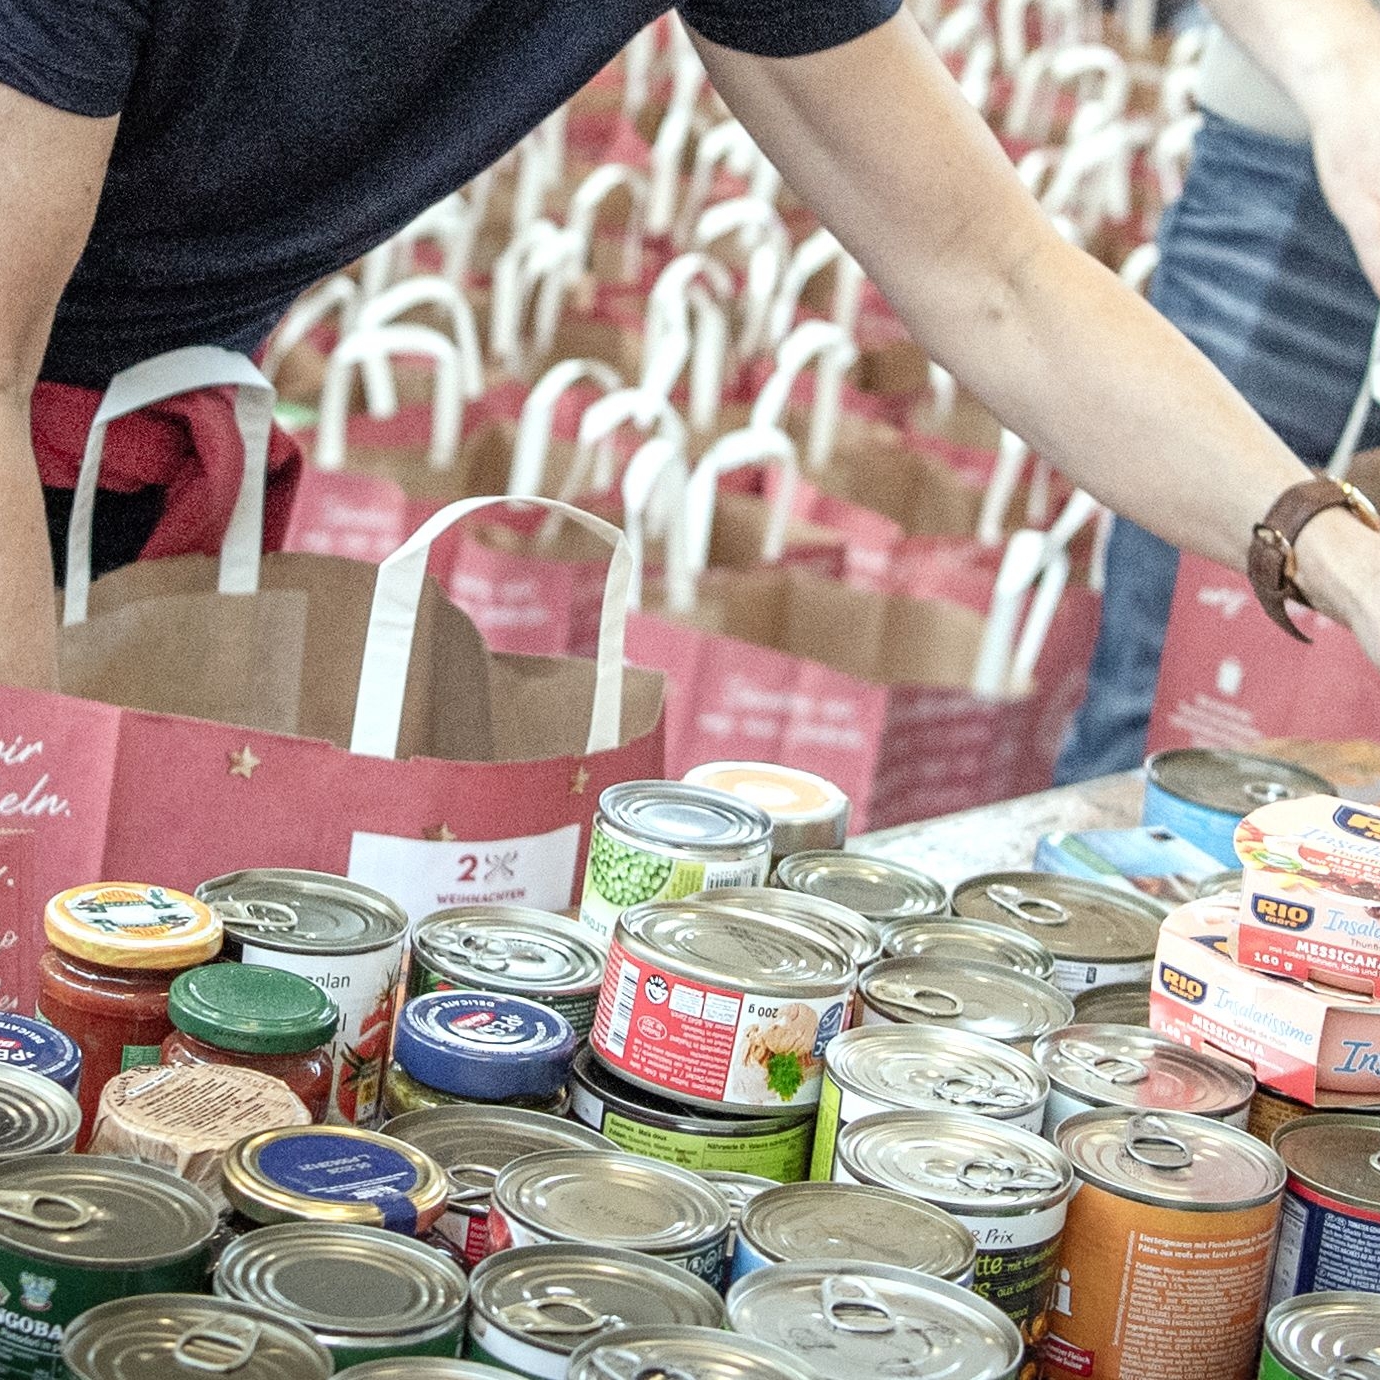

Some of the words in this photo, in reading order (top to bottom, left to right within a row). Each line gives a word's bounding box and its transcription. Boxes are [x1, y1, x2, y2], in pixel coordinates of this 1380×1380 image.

[1257, 898, 1309, 924] RIO
[1265, 915, 1299, 929] mare
[1253, 952, 1279, 966] 160
[1162, 968, 1204, 999] RIO
[758, 1006, 779, 1019] 200
[1214, 986, 1314, 1046] Insalatissime
[1191, 1014, 1266, 1056] MESSICANA
[985, 1228, 1014, 1244] Prix
